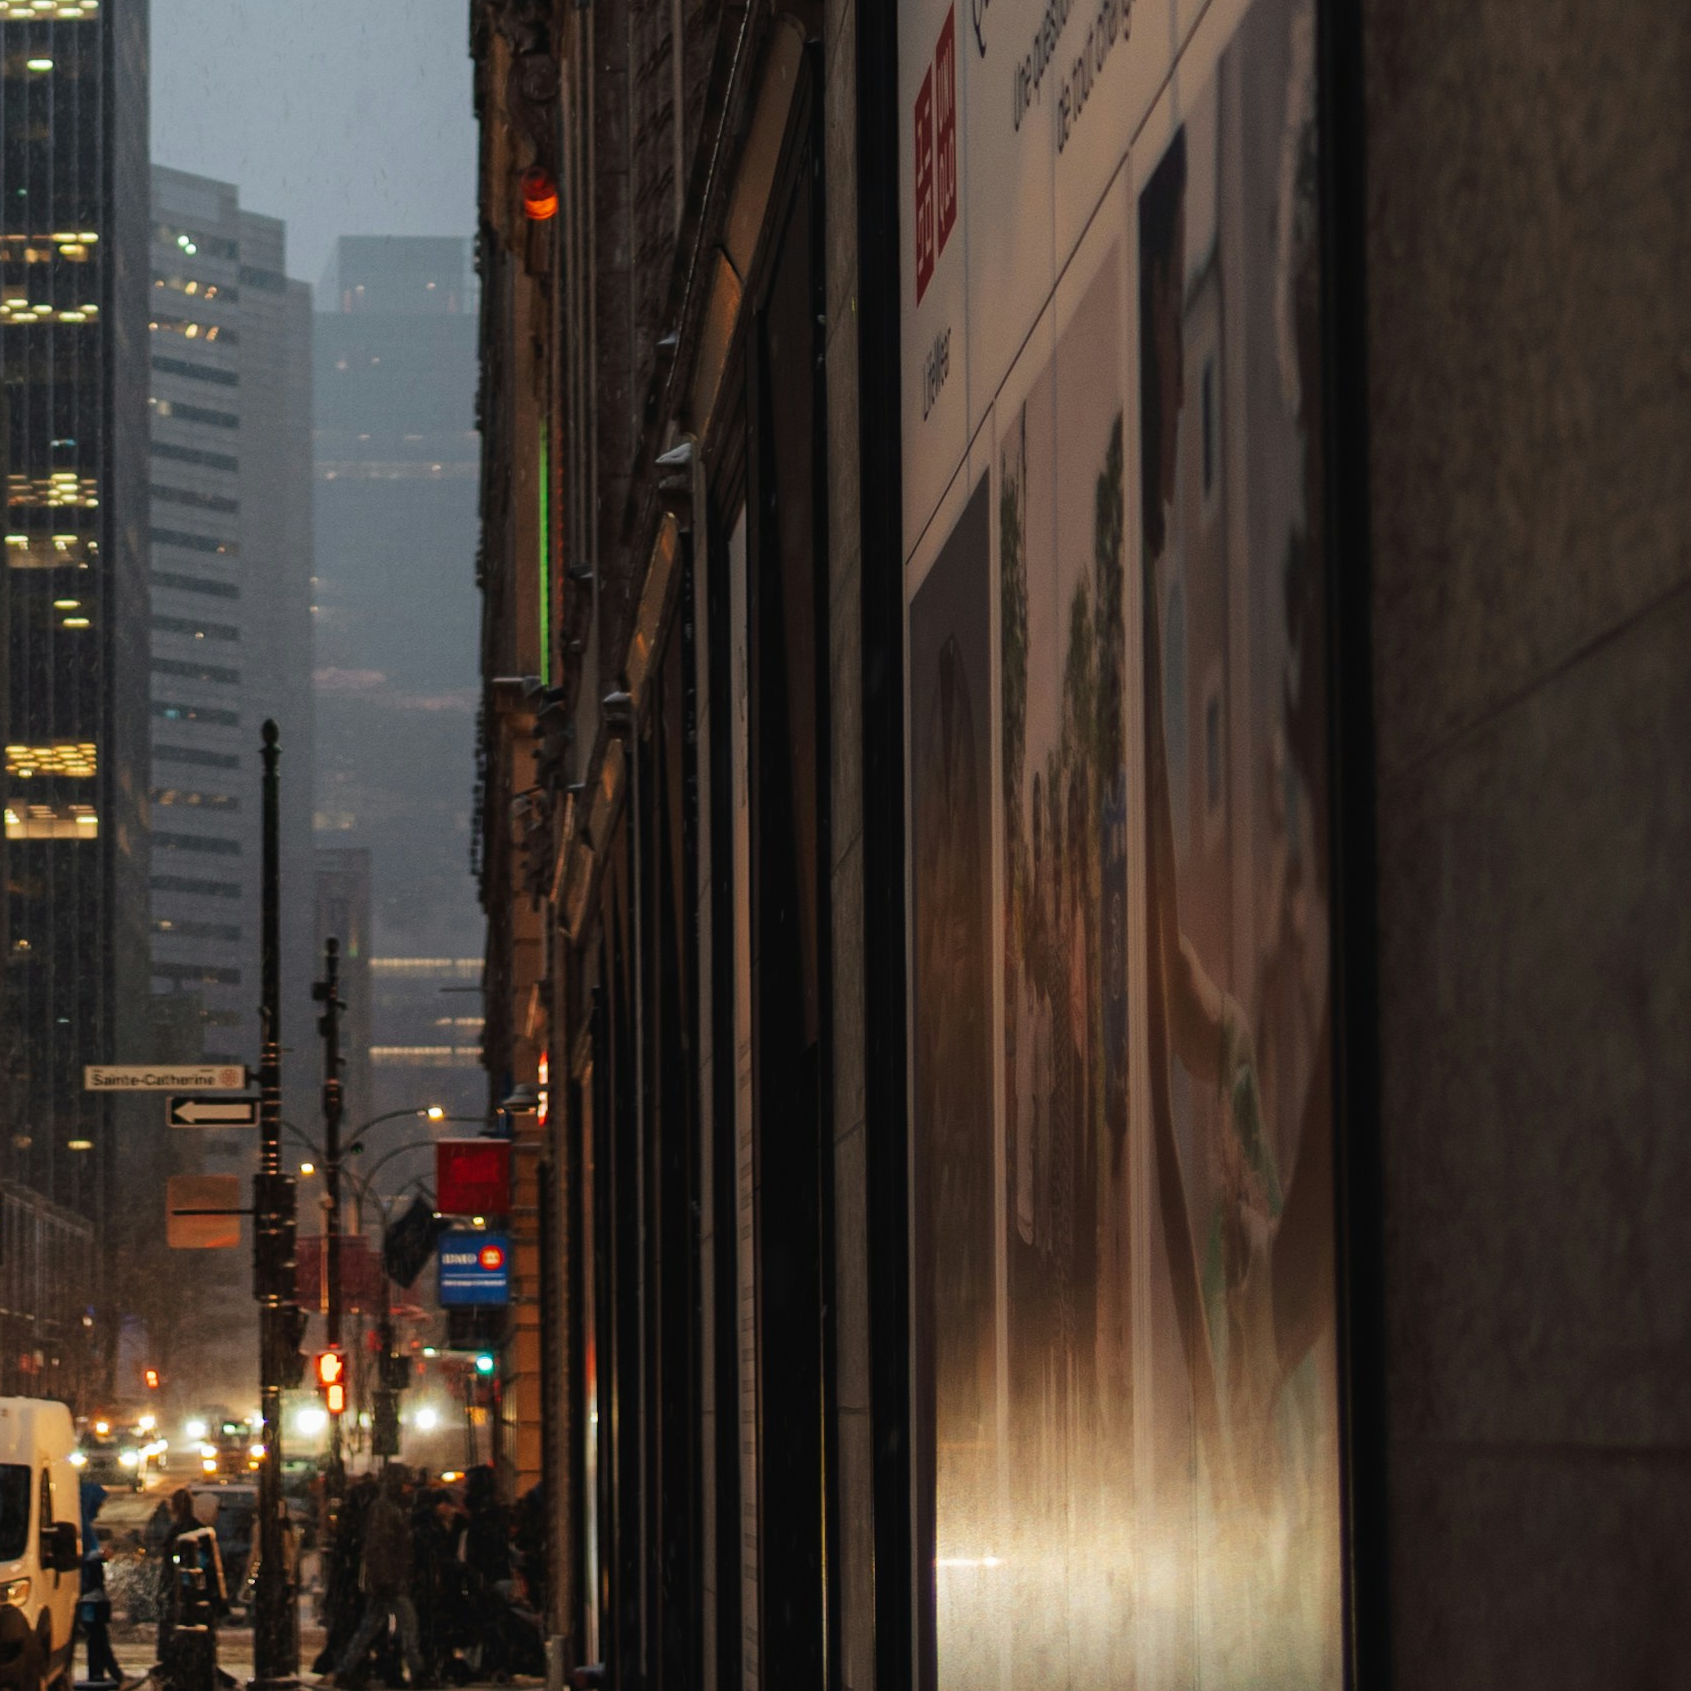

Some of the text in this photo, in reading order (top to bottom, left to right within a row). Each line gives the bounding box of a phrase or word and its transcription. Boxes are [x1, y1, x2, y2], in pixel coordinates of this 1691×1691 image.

[937, 38, 953, 134] UNI
[1058, 74, 1071, 154] de
[1072, 22, 1093, 121] tout
[939, 127, 954, 233] QLO
[92, 1074, 216, 1086] Sainte-Catherine
